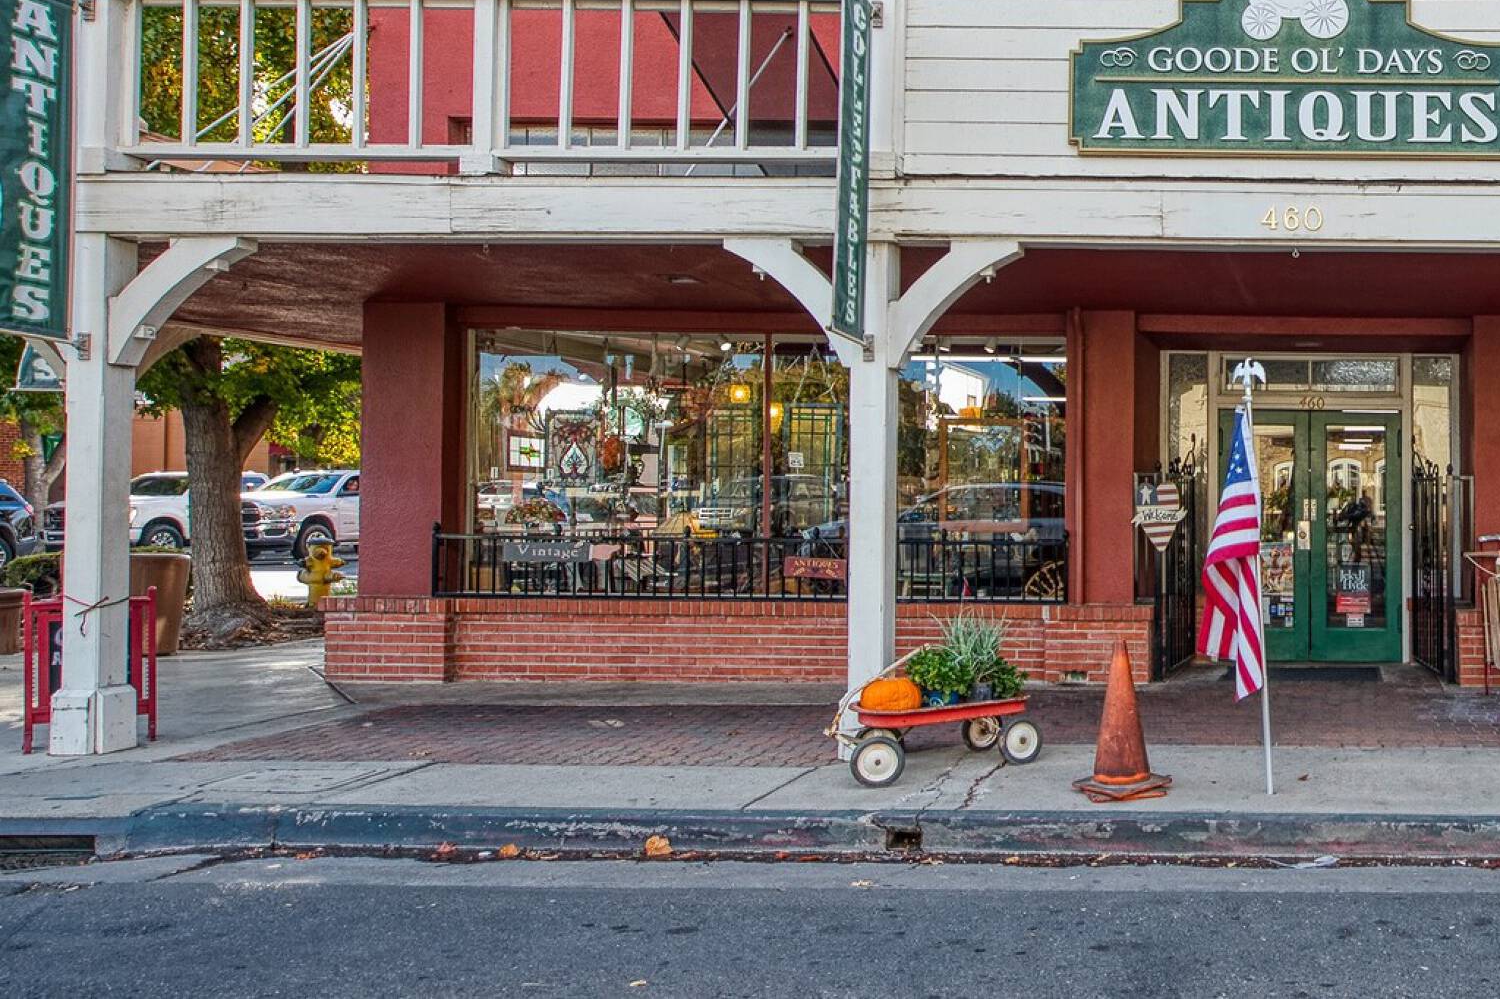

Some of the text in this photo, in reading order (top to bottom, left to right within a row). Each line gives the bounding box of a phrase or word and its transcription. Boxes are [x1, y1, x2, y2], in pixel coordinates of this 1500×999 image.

[1147, 46, 1443, 74] GOODE OL' DAYS
[1092, 88, 1498, 143] ANTIQUES
[1261, 205, 1323, 232] 460
[1299, 396, 1325, 410] 460
[518, 544, 579, 560] Vintage
